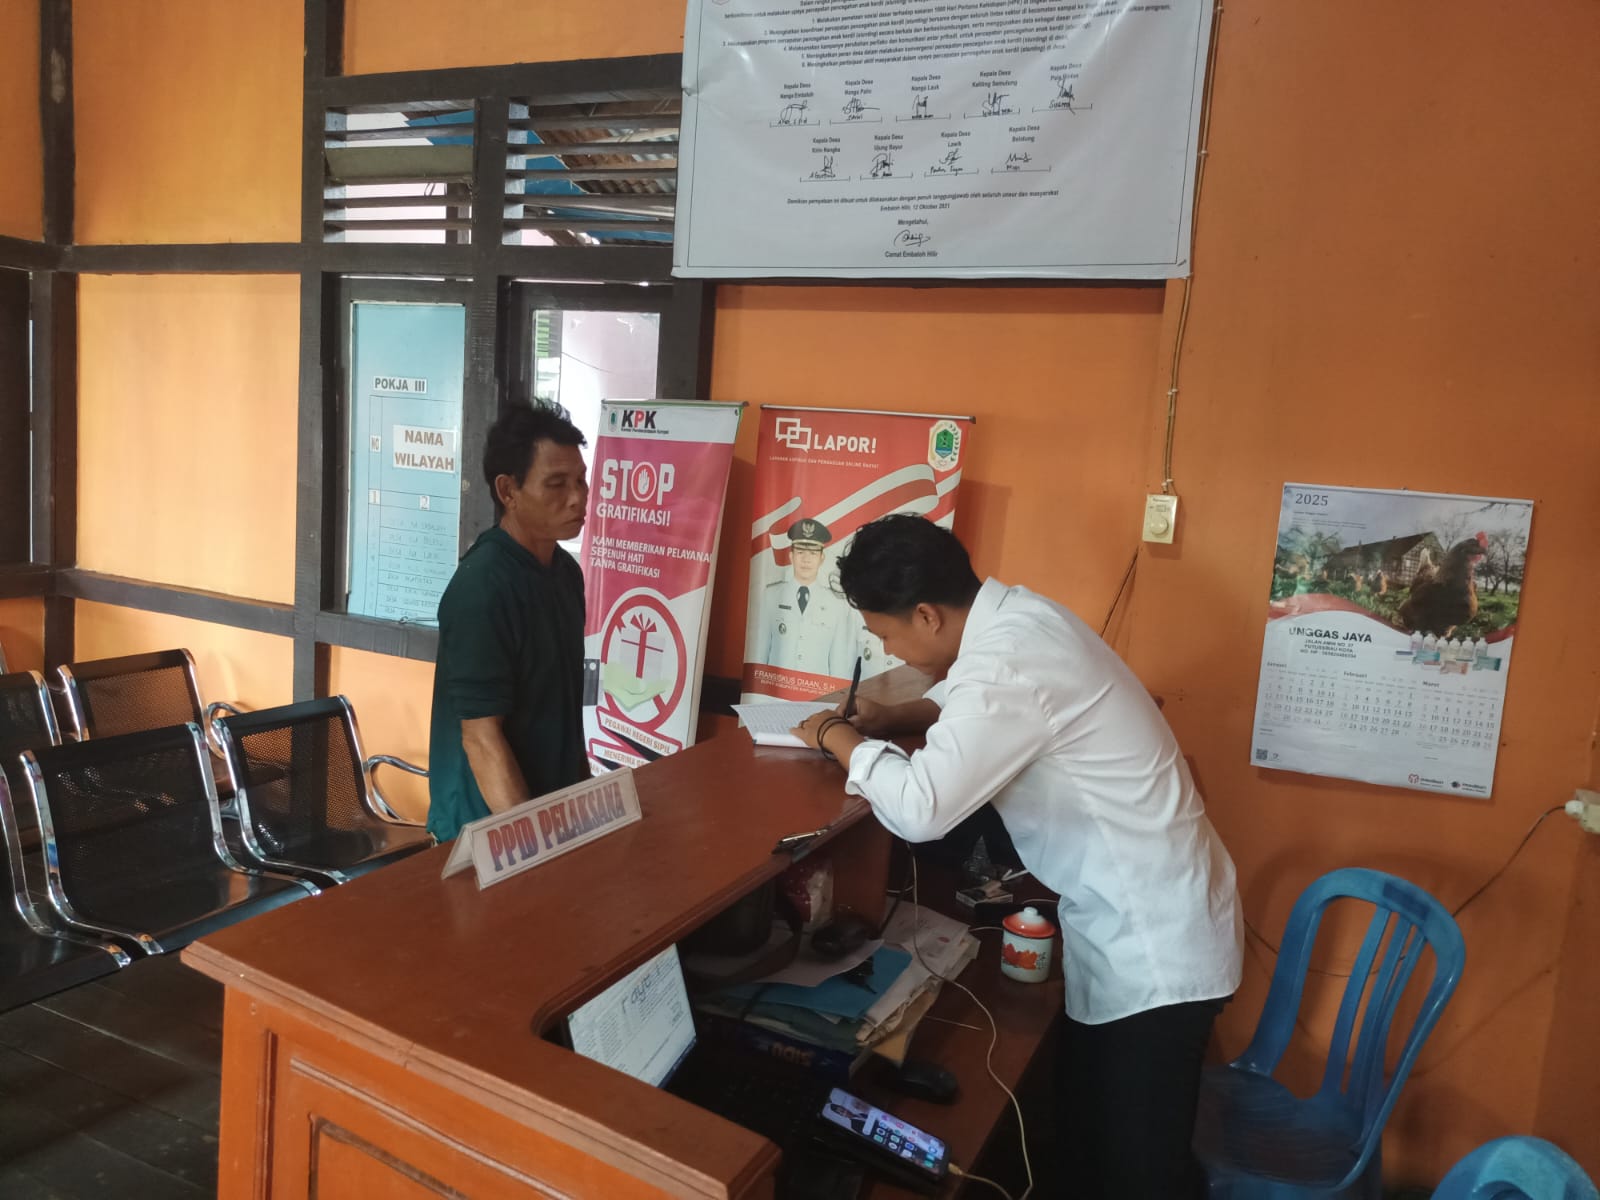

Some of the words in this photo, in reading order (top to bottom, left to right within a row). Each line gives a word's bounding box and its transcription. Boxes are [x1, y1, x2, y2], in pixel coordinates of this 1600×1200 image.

[374, 378, 408, 391] POKJA
[415, 380, 425, 392] III
[621, 410, 657, 429] KPK
[404, 430, 444, 446] NAMA
[813, 434, 877, 454] LAPOR!
[394, 452, 454, 471] WILAYAH
[600, 459, 675, 505] STOP
[1296, 493, 1329, 506] 2025
[596, 503, 671, 526] GRATIFIKASI!
[592, 535, 615, 547] KAMI
[615, 538, 665, 556] MEMBERIKAN
[591, 547, 627, 562] SEPENUH
[627, 552, 645, 564] HATI
[590, 556, 616, 571] TANPA
[616, 563, 661, 578] GRATIFIKASI
[1289, 627, 1339, 640] UNGGAS
[1343, 632, 1372, 643] JAYA
[604, 716, 631, 736] PEGAWAI
[632, 729, 652, 746] NEGERI
[653, 739, 671, 754] SIPIL
[604, 749, 635, 766] MENERIMA
[487, 816, 539, 872] PPID
[537, 782, 626, 850] PELAKSANA
